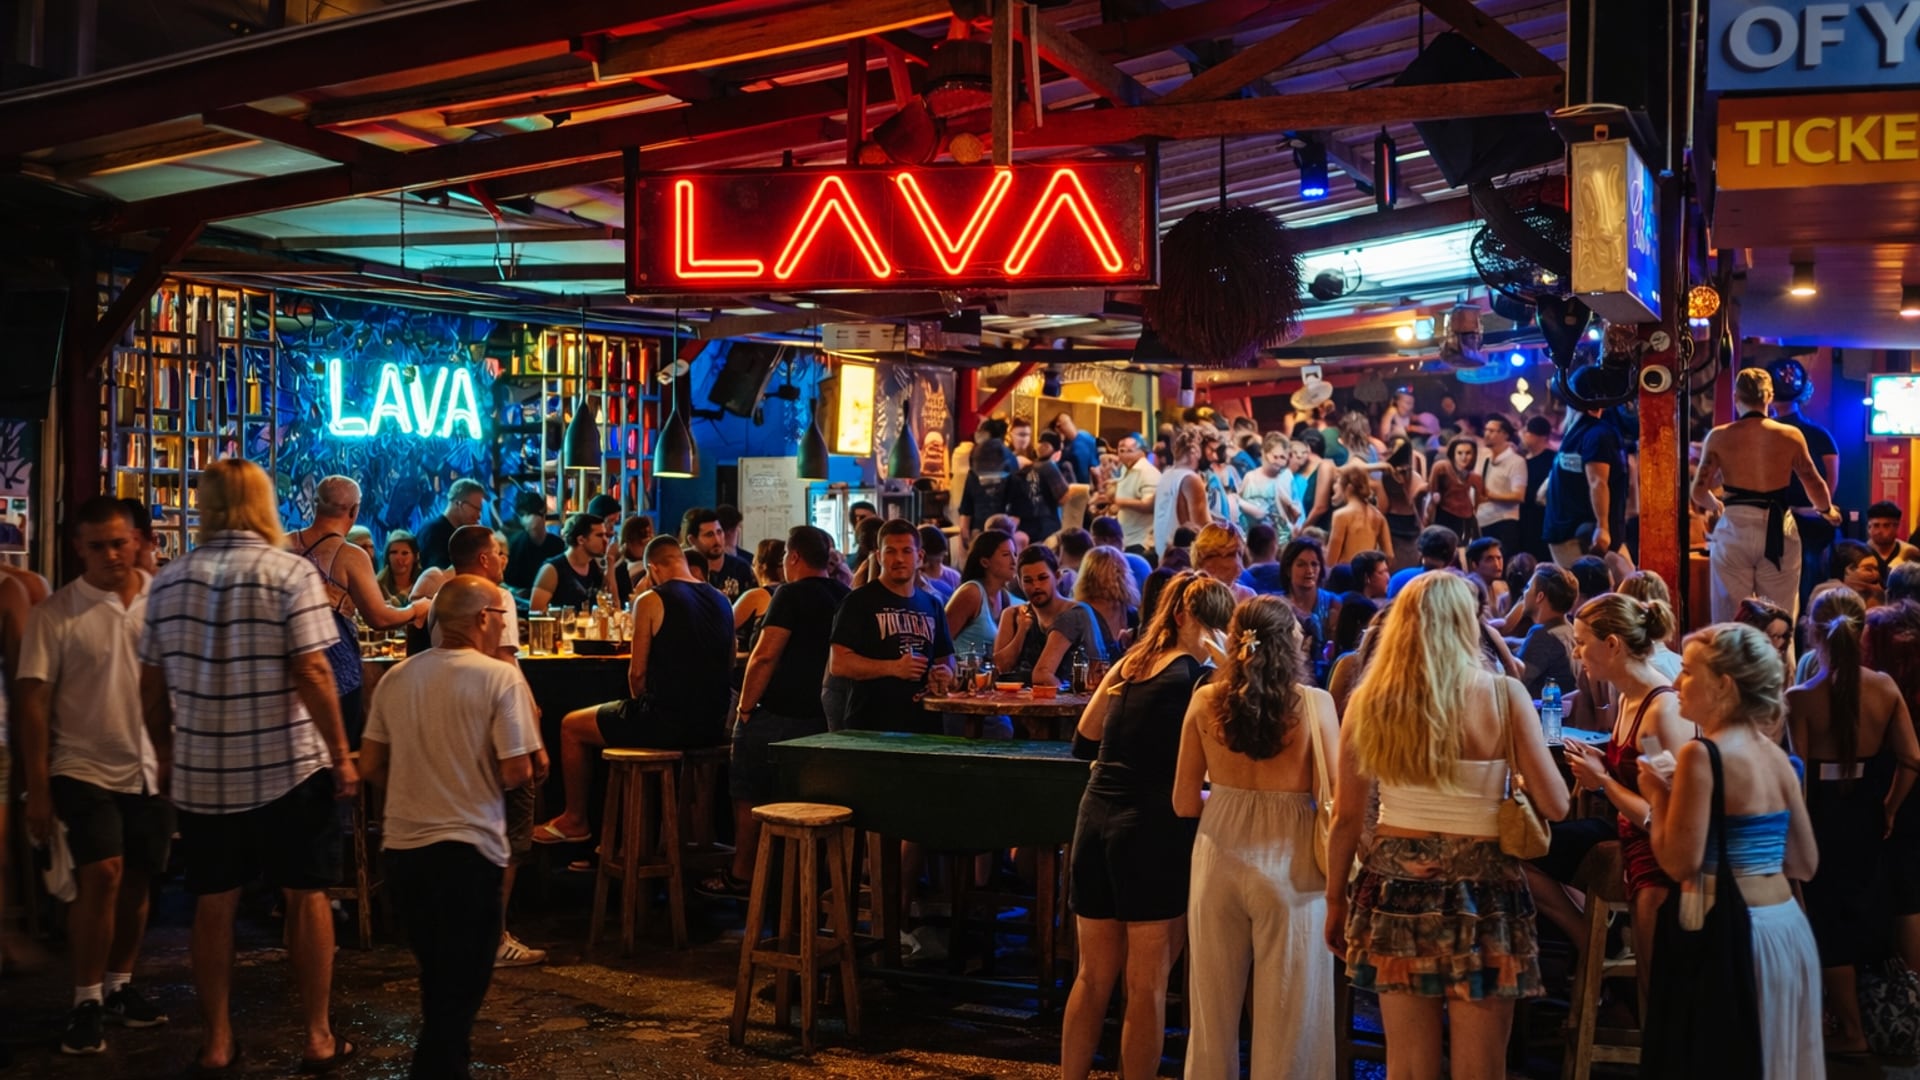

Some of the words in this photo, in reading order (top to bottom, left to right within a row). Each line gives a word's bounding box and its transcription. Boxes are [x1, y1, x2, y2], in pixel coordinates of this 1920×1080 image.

[1729, 3, 1849, 68] OF
[1864, 1, 1920, 63] Y
[675, 168, 1123, 278] LAVA
[329, 357, 483, 440] LAVA
